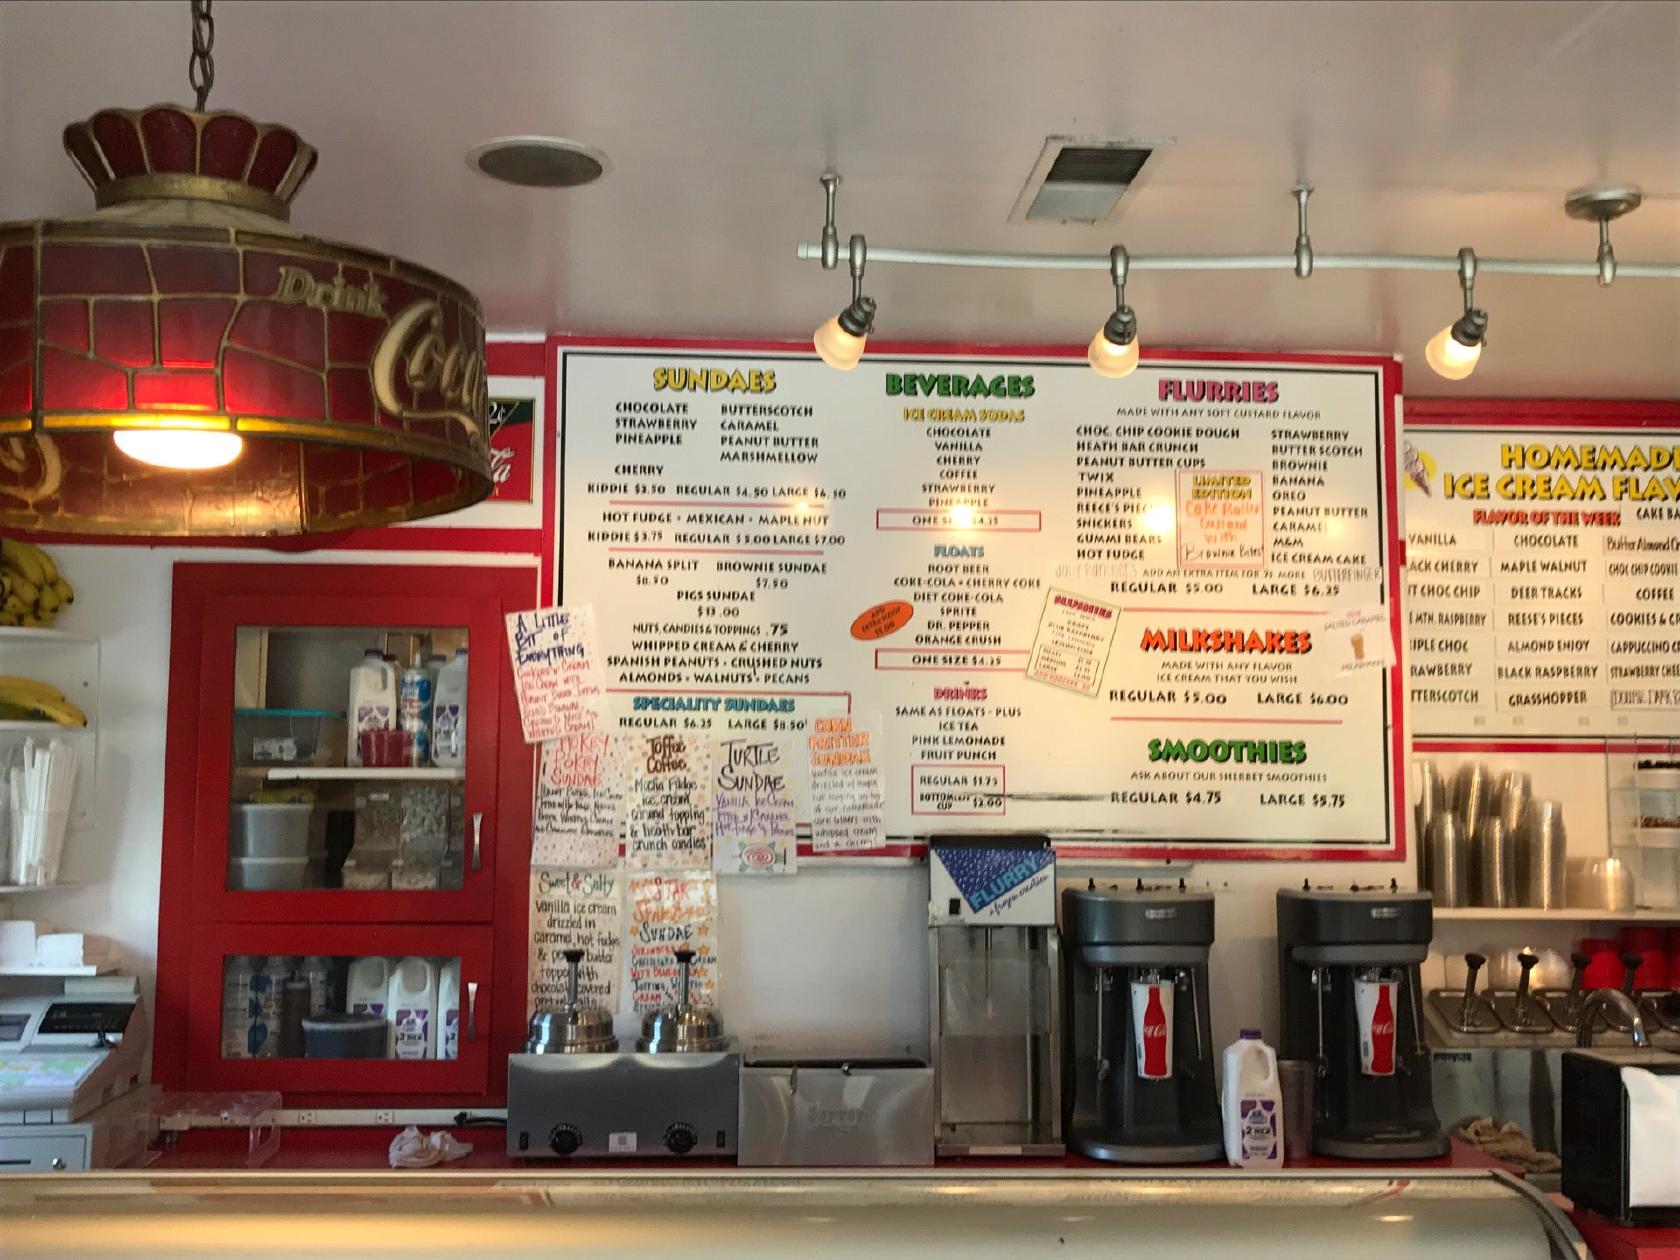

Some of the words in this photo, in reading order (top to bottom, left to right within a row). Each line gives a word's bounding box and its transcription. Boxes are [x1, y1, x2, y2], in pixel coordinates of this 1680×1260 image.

[279, 265, 387, 316] Drink
[653, 367, 777, 394] SUNDAES
[886, 373, 1036, 398] BEVERAGES
[1158, 379, 1279, 404] FLURRIES
[615, 402, 688, 415] CHOCOLATE
[720, 404, 813, 418] BUTTERSCOTCH
[904, 407, 924, 421] ICE
[927, 408, 977, 422] CREAM
[979, 408, 1025, 423] SODAS
[615, 418, 697, 431] STRAWBERRY
[720, 420, 778, 432] CARAMEL
[926, 427, 991, 438] CHOCOLATE
[1076, 425, 1112, 438] CHOC.
[1116, 426, 1145, 438] CHIP
[1147, 427, 1192, 439] COOKIE
[1196, 427, 1240, 439] DOUGH
[1271, 429, 1349, 442] STRAWBERRY
[615, 433, 682, 446] PINEAPPLE
[720, 436, 770, 448] PEANUT
[773, 437, 819, 448] BUTTER
[935, 441, 983, 451] VANILLA
[1076, 441, 1118, 453] HEATH
[1121, 442, 1146, 453] BAR
[1149, 442, 1199, 453] CRUNCH
[1271, 445, 1316, 456] BUTTER
[1319, 446, 1363, 457] SCOTCH
[720, 451, 818, 464] MARSHMELLOW
[937, 456, 980, 466] CHERRY
[1076, 457, 1125, 468] PEANUT
[1128, 457, 1174, 468] BUTTER
[1177, 458, 1206, 468] CUPS
[615, 465, 664, 476] CHERRY
[1272, 460, 1328, 472] BROWNIE
[940, 470, 977, 479] COFFEE
[1078, 472, 1114, 482] TWIX
[1272, 476, 1325, 487] BANANA
[1444, 473, 1490, 500] ICE
[1496, 473, 1606, 501] CREAM
[922, 484, 995, 493] STRAWBERRY
[1076, 487, 1142, 499] PINEAPPLE
[1272, 491, 1305, 501] OREO
[1273, 506, 1321, 518] PEANUT
[1325, 507, 1368, 518] BUTTER
[1473, 508, 1528, 525] FLAVOR
[1530, 510, 1550, 525] OF
[1552, 510, 1579, 526] THE
[1582, 511, 1620, 528] WEEK
[1637, 506, 1663, 521] CAKE
[602, 513, 629, 523] HOT
[633, 513, 672, 524] FUDGE
[686, 513, 745, 525] MEXICAN
[758, 514, 800, 526] MAPLE
[803, 515, 828, 526] NUT
[1076, 518, 1132, 529] SNICKERS
[1514, 535, 1578, 548] CHOCOLATE
[934, 544, 985, 558] FLOATS
[1077, 549, 1102, 560] HOT
[1107, 550, 1145, 561] FUDGE
[1271, 554, 1288, 565] ICE
[1291, 555, 1333, 565] CREAM
[1336, 555, 1367, 565] CAKE
[608, 559, 662, 569] BANANA
[667, 560, 699, 571] SPLIT
[716, 561, 775, 573] BROWNIE
[779, 562, 827, 574] SUNDAE
[928, 564, 959, 574] ROOT
[963, 565, 989, 574] BEER
[1435, 560, 1478, 573] CHERRY
[1500, 560, 1537, 573] MAPLE
[1540, 560, 1587, 573] WALNUT
[677, 590, 703, 601] PIGS
[706, 591, 756, 601] SUNDAE
[1421, 585, 1452, 598] CHOC
[1453, 585, 1481, 598] CHIP
[1511, 586, 1539, 599] DEER
[1541, 586, 1582, 599] TRACKS
[1636, 588, 1674, 601] COFFEE
[940, 607, 977, 617] SPRITE
[928, 621, 945, 630] DR.
[949, 621, 990, 631] PEPPER
[916, 635, 962, 645] ORANGE
[965, 635, 1001, 645] CRUSH
[1140, 628, 1312, 654] MILKSHAKES
[1439, 639, 1468, 652] CHOC
[1509, 639, 1554, 652] ALMOND
[1558, 639, 1590, 652] ENJOY
[632, 641, 690, 651] WHIPPED
[693, 641, 735, 652] CREAM
[750, 642, 799, 653] CHERRY
[1610, 640, 1670, 654] CAPPUCCINO
[607, 657, 660, 668] SPANISH
[664, 658, 719, 668] PEANUTS
[731, 658, 788, 669] CRUSHED
[791, 659, 823, 669] NUTS
[619, 672, 682, 684] ALMONDS
[694, 673, 751, 684] WALNUTS
[764, 674, 810, 684] PECANS
[1498, 666, 1532, 679] BLACK
[1536, 666, 1598, 679] RASPBERRY
[1610, 665, 1659, 679] STRAWBERRY
[933, 687, 988, 700] DRINKS
[1109, 690, 1176, 702] REGULAR
[1184, 691, 1227, 704] $5.00
[1257, 693, 1303, 705] LARGE
[1310, 694, 1348, 706] $6.00
[1509, 690, 1587, 707] GRASSHOPPER
[633, 696, 721, 711] SPECIALITY
[725, 698, 795, 713] SUNDAES
[896, 706, 926, 717] SAME
[929, 706, 942, 717] AS
[946, 707, 985, 717] FLOATS
[996, 707, 1022, 717] PLUS
[939, 722, 955, 731] ICE
[959, 722, 978, 731] TEA
[647, 733, 686, 755] Toffee
[913, 735, 939, 745] PINK
[943, 736, 1005, 746] LEMONADE
[921, 750, 954, 760] FRUIT
[957, 751, 996, 760] PUNCH
[1148, 738, 1307, 764] SMOOTHIES
[646, 756, 687, 774] Coffee
[1110, 792, 1178, 804] REGULAR
[1186, 790, 1222, 804] $4.75
[1260, 793, 1305, 806] LARGE
[937, 802, 953, 811] CUP
[970, 856, 1038, 908] FLURRY
[585, 915, 596, 928] in
